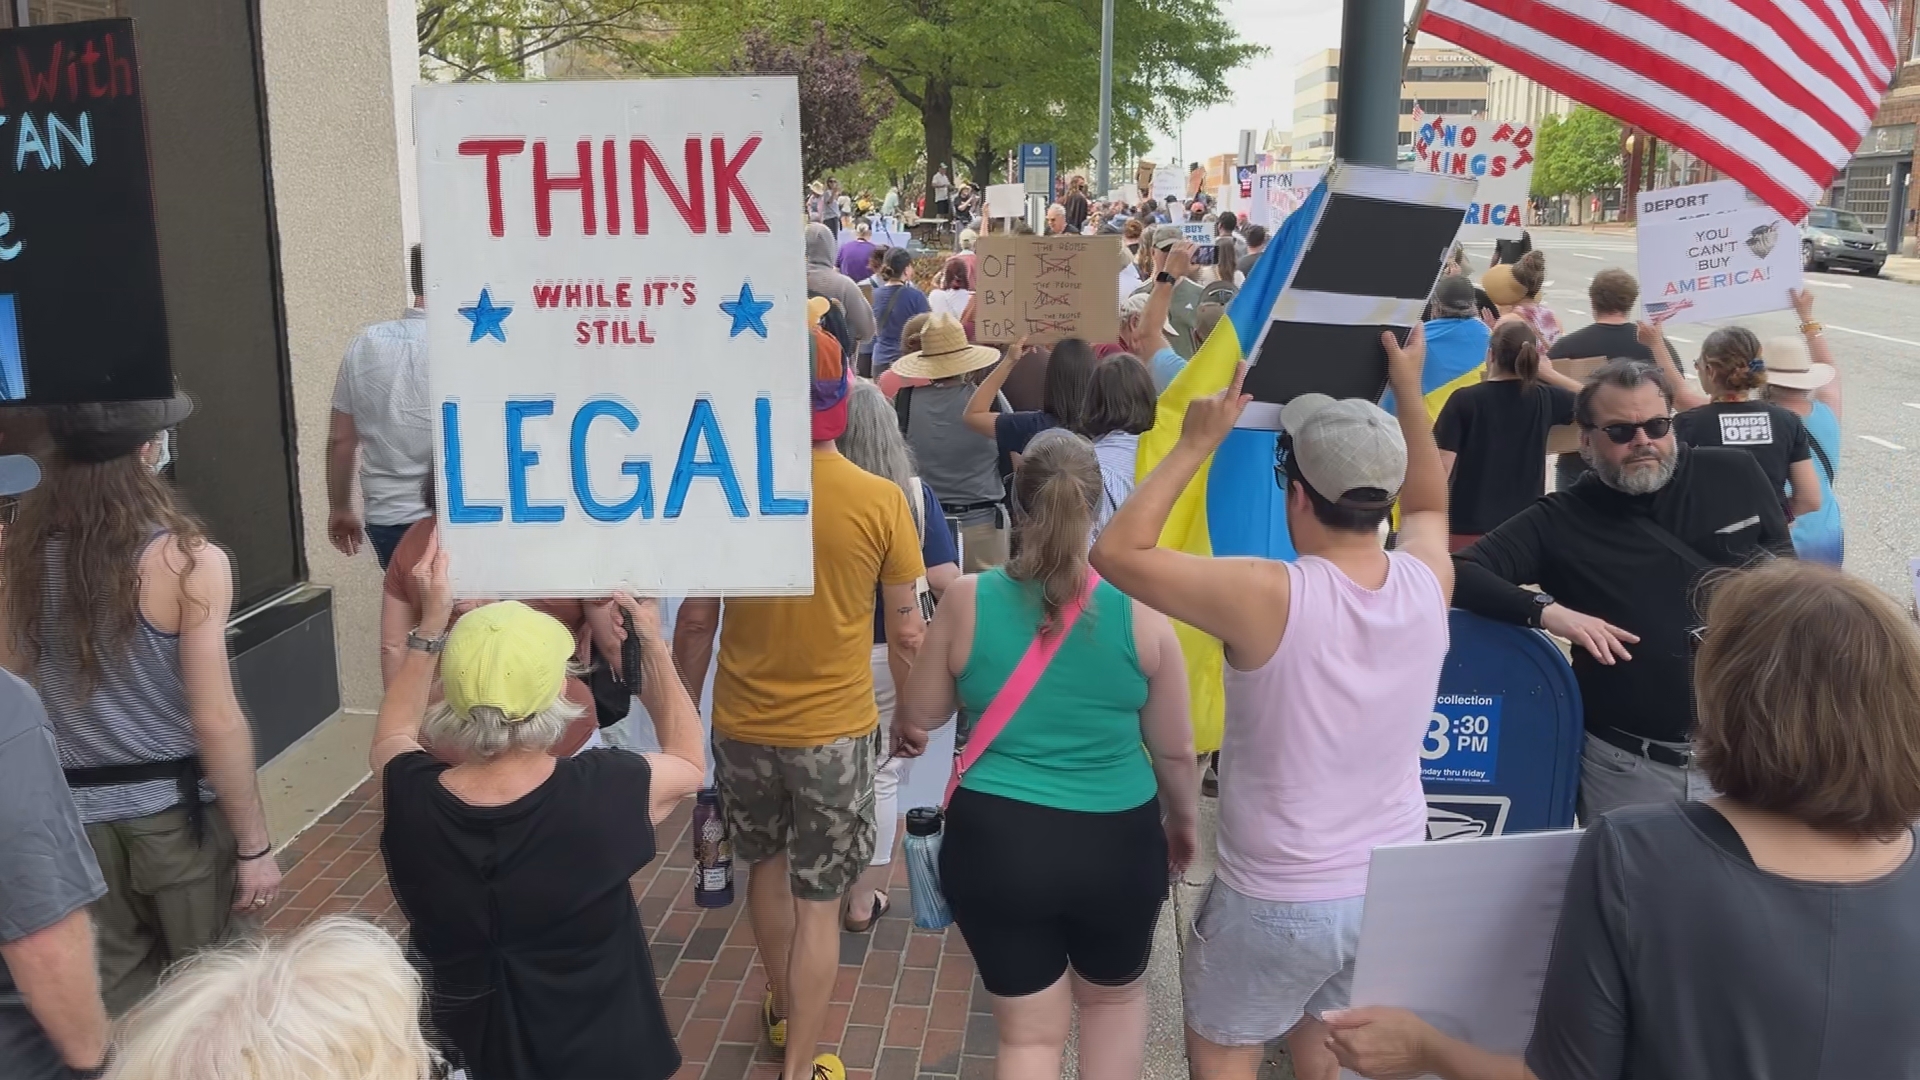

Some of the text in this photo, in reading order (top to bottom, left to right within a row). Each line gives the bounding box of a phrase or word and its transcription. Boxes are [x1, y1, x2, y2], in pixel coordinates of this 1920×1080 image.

[16, 33, 133, 103] With
[1444, 125, 1478, 148] NO
[1430, 150, 1508, 177] KINGS
[457, 136, 771, 237] THINK
[1644, 194, 1709, 213] DEPORT
[1464, 202, 1521, 227] RICA
[1185, 225, 1203, 233] BUY
[1696, 228, 1729, 241] YOU
[1032, 242, 1053, 252] THE
[1688, 241, 1738, 258] CAN'T
[983, 254, 1015, 277] OF
[1698, 257, 1730, 270] BUY
[1664, 267, 1771, 296] AMERICA!
[533, 282, 697, 308] WHILE IT'S
[985, 290, 1013, 305] BY
[576, 321, 655, 344] STILL
[983, 319, 1015, 337] FOR
[1723, 416, 1767, 427] HANDS
[1725, 426, 1768, 440] OFF!
[442, 397, 809, 524] LEGAL
[1437, 695, 1493, 705] collection
[1457, 736, 1489, 752] PM
[1421, 768, 1442, 776] nday
[1462, 770, 1486, 778] friday
